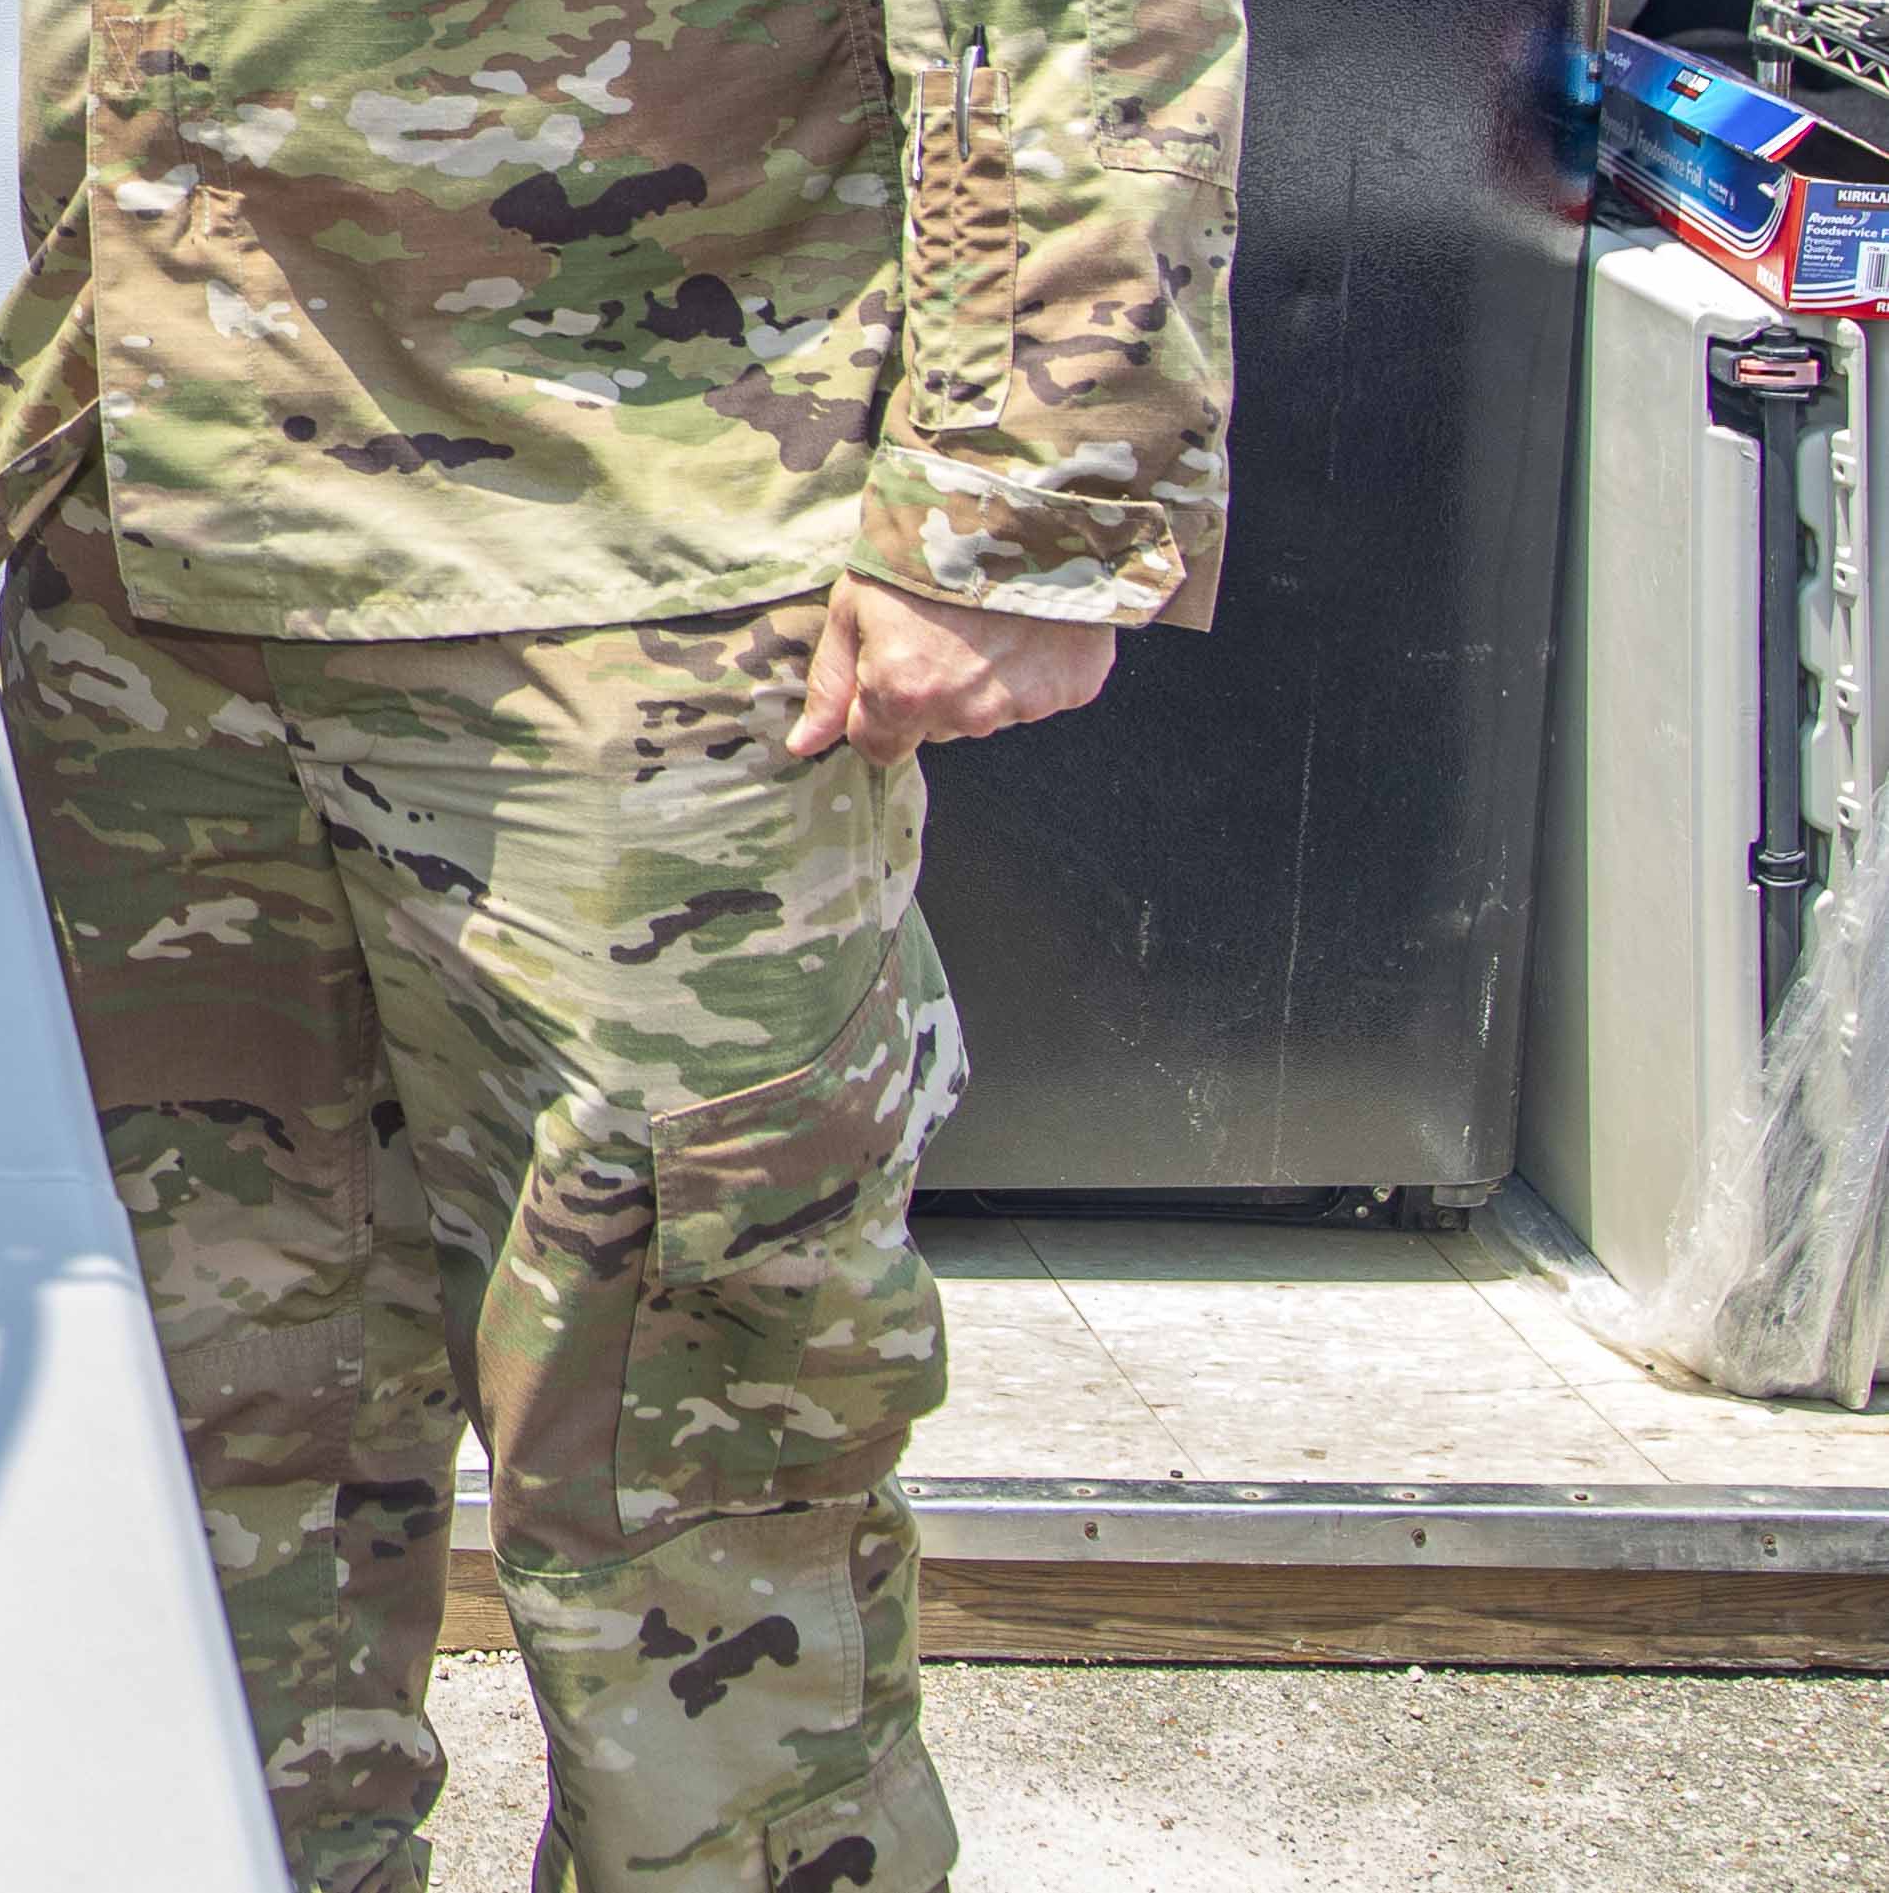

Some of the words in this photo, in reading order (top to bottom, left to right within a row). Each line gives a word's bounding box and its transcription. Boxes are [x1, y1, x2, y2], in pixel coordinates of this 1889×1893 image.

[1686, 162, 1702, 188] Foil
[1808, 212, 1856, 227] Reynolds
[1806, 226, 1878, 239] Foodservice
